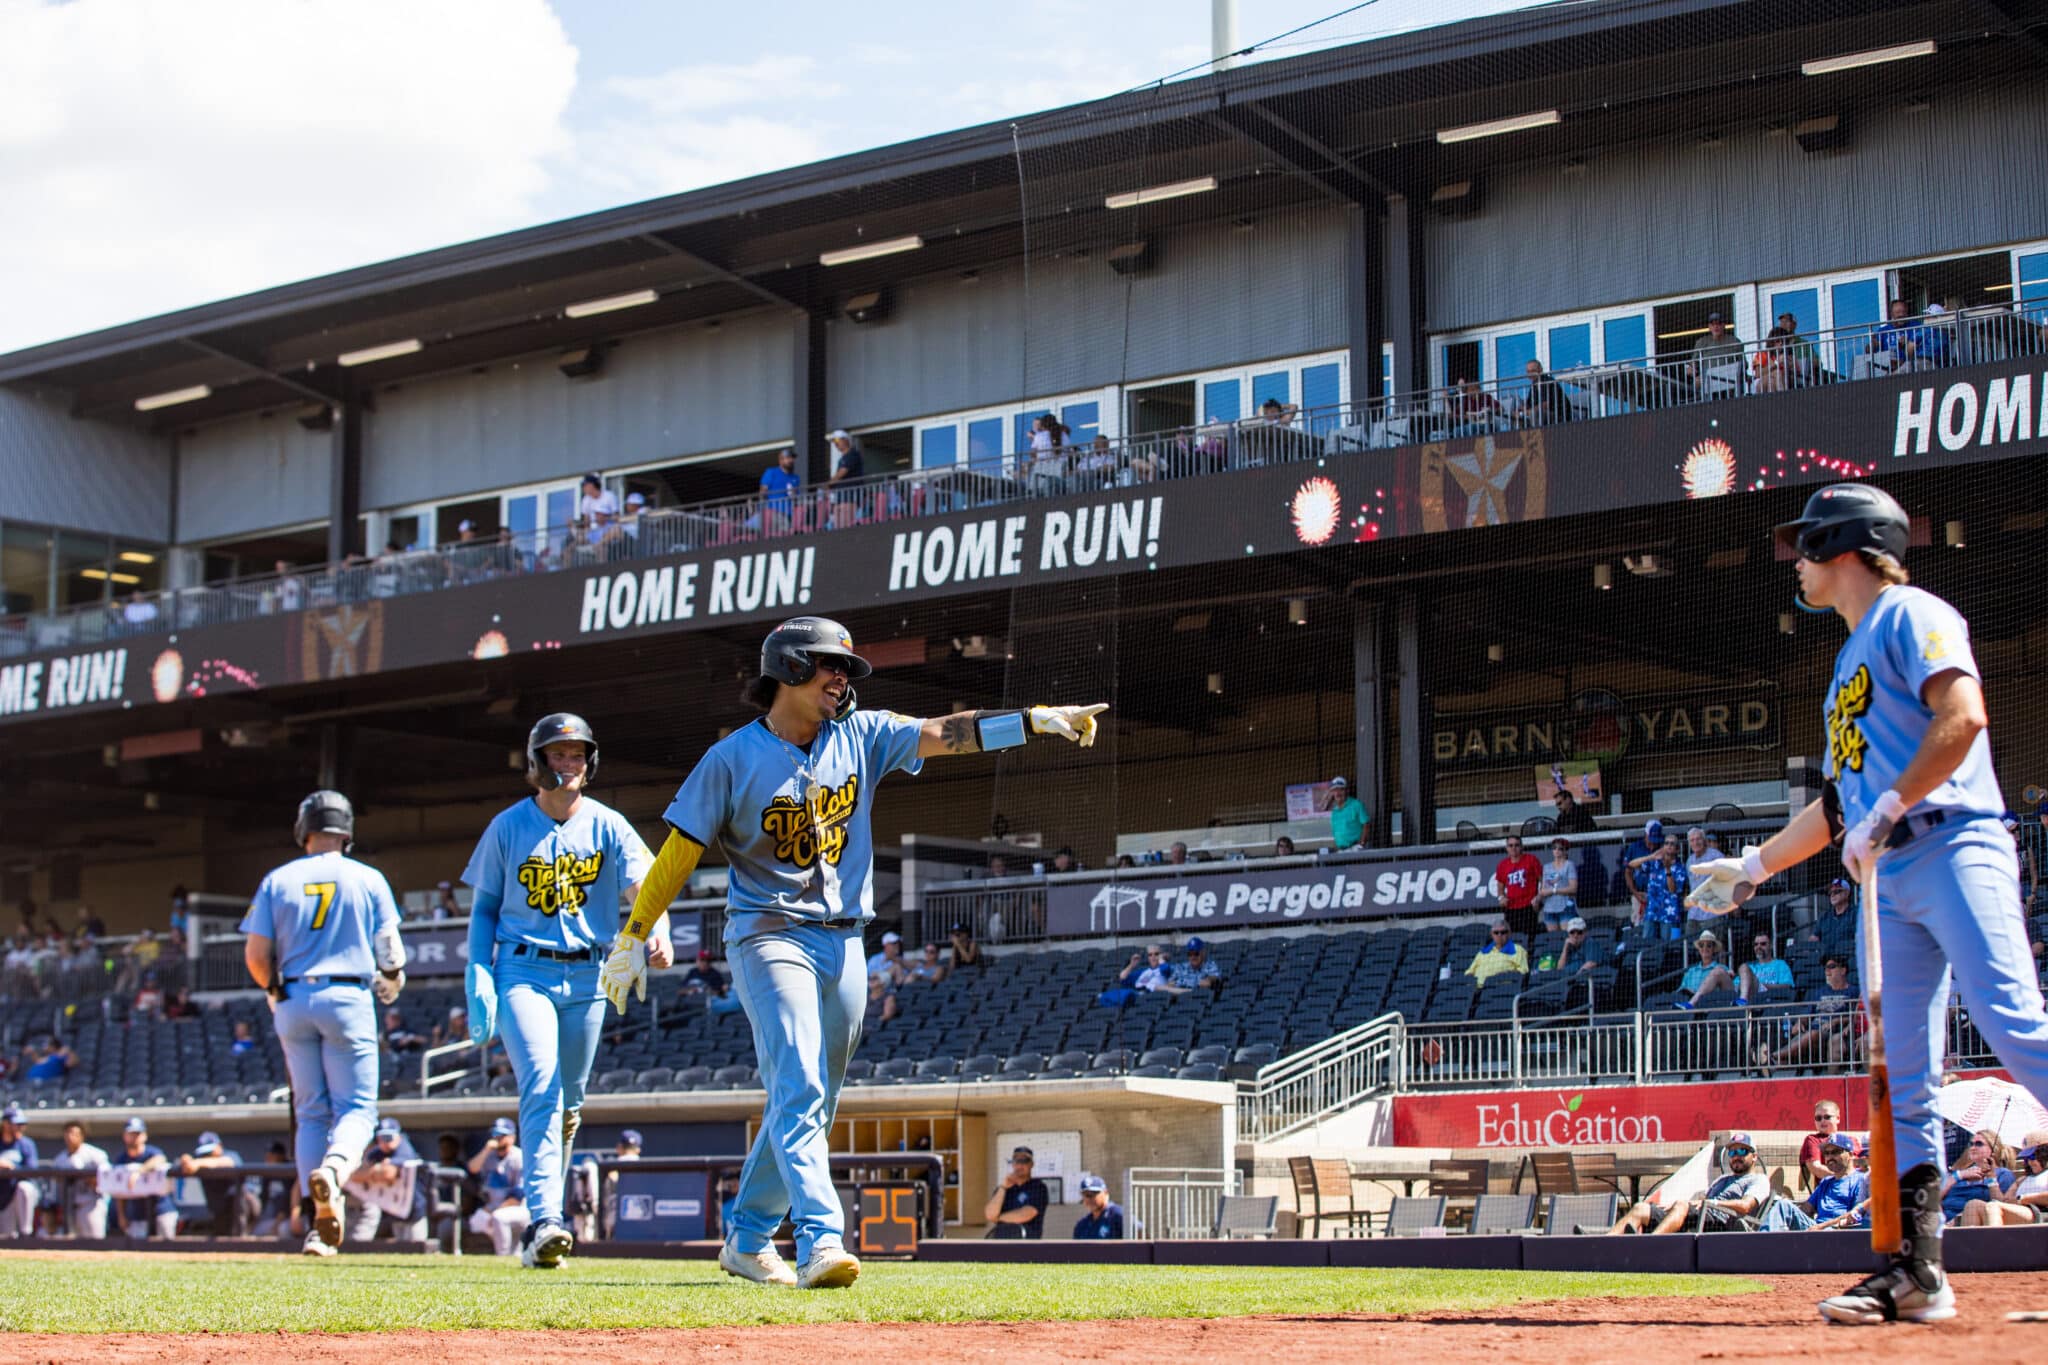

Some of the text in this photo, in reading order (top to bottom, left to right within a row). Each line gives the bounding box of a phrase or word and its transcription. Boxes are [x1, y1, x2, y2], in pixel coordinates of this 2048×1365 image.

[889, 496, 1163, 591] HOME RUN!
[579, 546, 815, 633] HOME RUN!
[46, 648, 127, 708] RUN!
[1434, 701, 1770, 760] BARN YARD
[518, 851, 603, 893] Yellow
[1153, 885, 1217, 920] The
[1224, 875, 1365, 918] Pergola
[303, 882, 337, 930] 7
[1475, 1101, 1666, 1148] EduCation
[859, 1188, 918, 1252] 25
